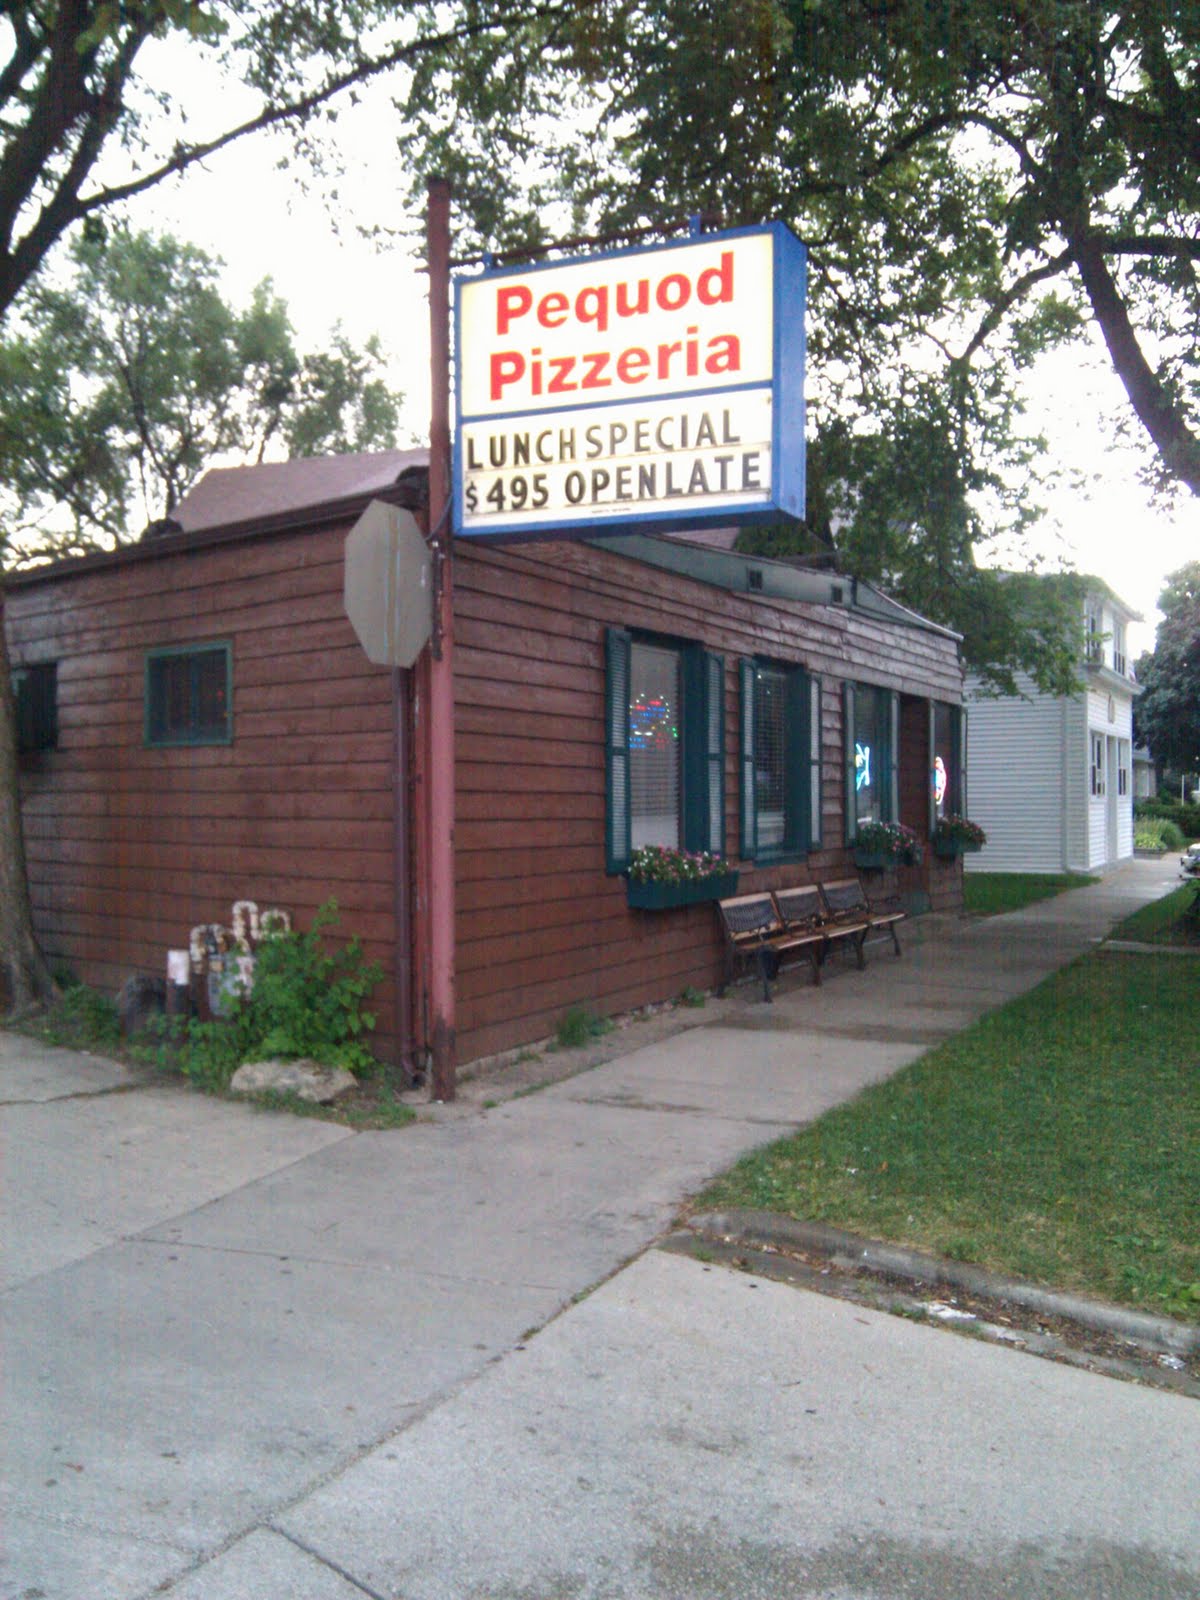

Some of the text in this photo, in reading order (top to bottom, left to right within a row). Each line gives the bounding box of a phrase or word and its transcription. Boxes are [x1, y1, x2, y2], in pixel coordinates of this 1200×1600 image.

[496, 251, 734, 335] Pequod
[490, 326, 741, 400] Pizzeria
[467, 409, 741, 470] LUNCH SPECIAL
[465, 452, 761, 513] $495 OPEN LATE
